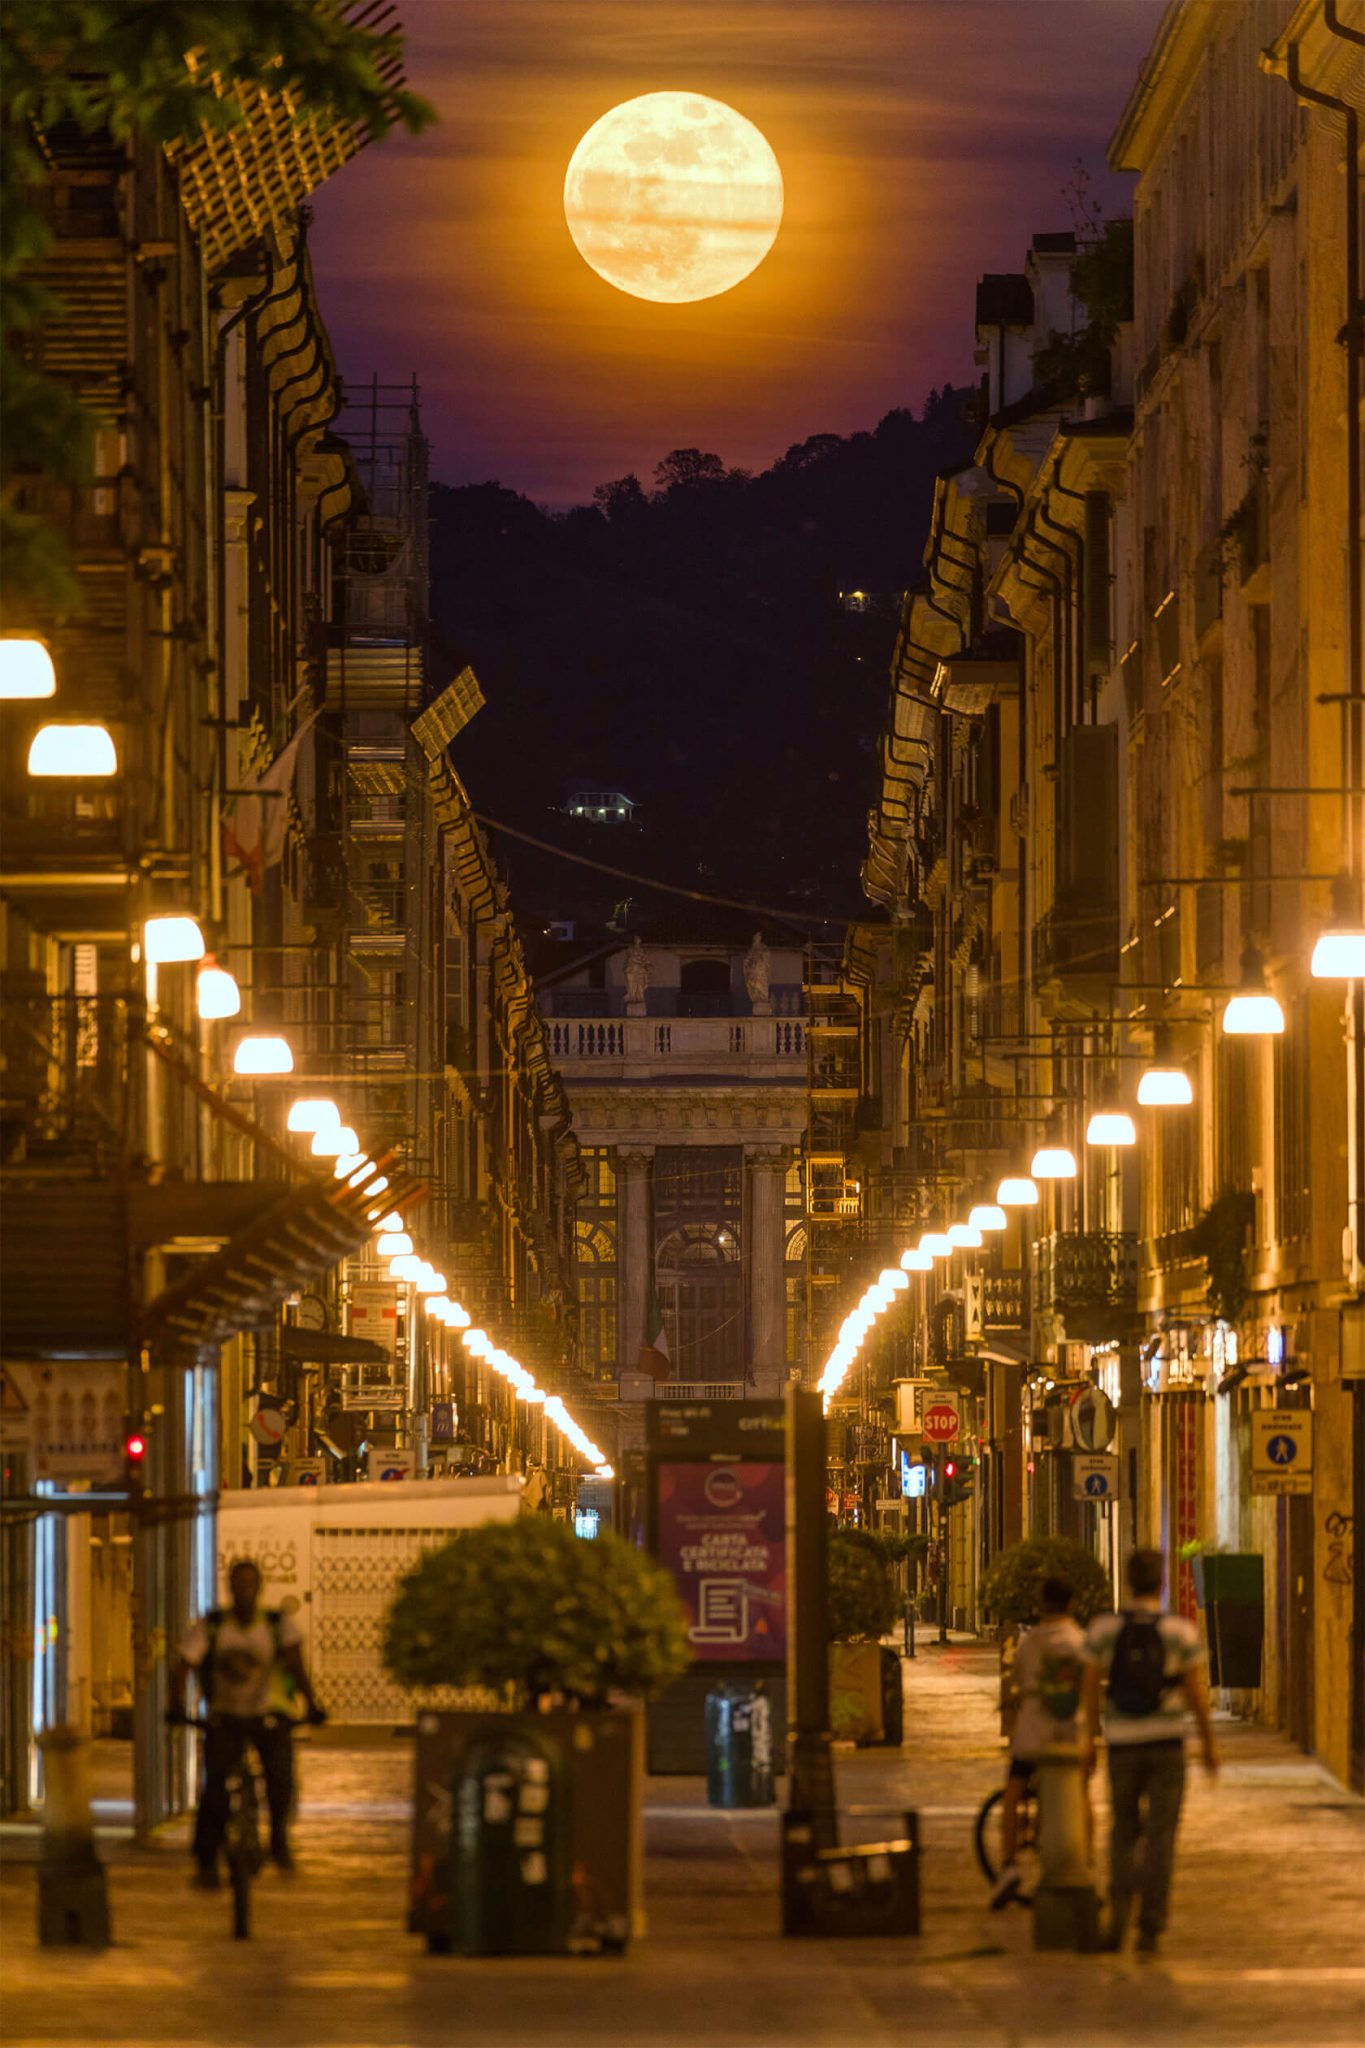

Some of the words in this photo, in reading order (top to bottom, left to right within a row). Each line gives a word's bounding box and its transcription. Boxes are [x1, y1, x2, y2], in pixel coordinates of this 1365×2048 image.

[926, 1415, 957, 1430] STOP
[702, 1533, 748, 1546] CARTA
[680, 1546, 769, 1559] CERTIFICATA
[683, 1559, 693, 1572] E
[696, 1559, 767, 1571] RICICLATA
